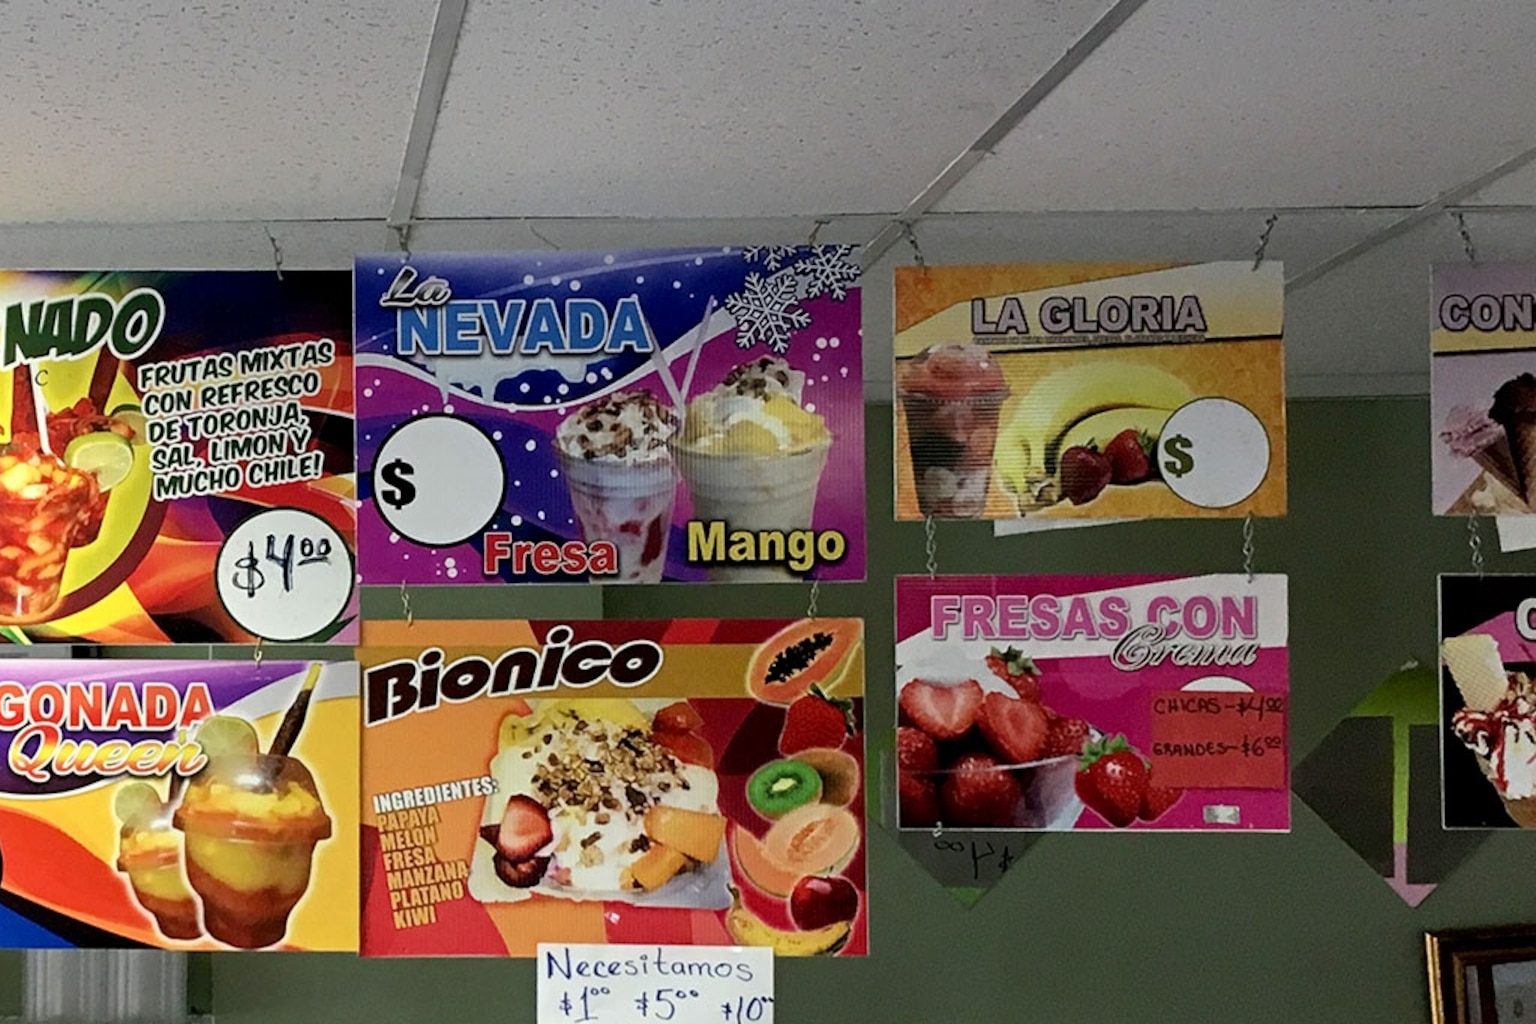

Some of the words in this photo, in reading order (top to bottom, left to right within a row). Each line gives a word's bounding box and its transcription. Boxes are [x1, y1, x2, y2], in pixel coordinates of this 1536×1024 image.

[381, 266, 452, 307] La
[399, 299, 653, 355] NEVADA
[970, 296, 1029, 335] LA
[1039, 295, 1207, 335] GLORIA
[1439, 293, 1536, 332] CON
[141, 356, 233, 389] FRUTAS
[241, 342, 332, 374] MIXTAS
[144, 390, 192, 415] CON
[201, 372, 319, 408] REFRESCO
[149, 420, 179, 443] DE
[187, 403, 306, 437] TORONJA,
[152, 445, 202, 470] SAL,
[211, 432, 285, 462] LIMON
[292, 429, 308, 450] Y
[1164, 434, 1194, 478] $
[156, 467, 240, 498] MUCHO
[249, 453, 321, 485] CHILE!
[381, 458, 416, 509] $
[483, 532, 618, 575] Fresa
[687, 521, 846, 570] Mango
[930, 594, 1130, 640] FRESAS
[1147, 594, 1257, 640] CON
[1110, 623, 1261, 672] Crema
[367, 628, 660, 724] Bionico
[9, 723, 207, 781] Queen
[373, 776, 500, 813] INGREDIENTES:
[378, 806, 440, 832] PAPAYA
[380, 826, 438, 852] MELON
[383, 846, 436, 871] FRESA
[386, 860, 468, 890] MANZANA
[390, 881, 464, 910] PLATANO
[393, 905, 437, 929] KIWI
[547, 947, 754, 983] Necesitamos
